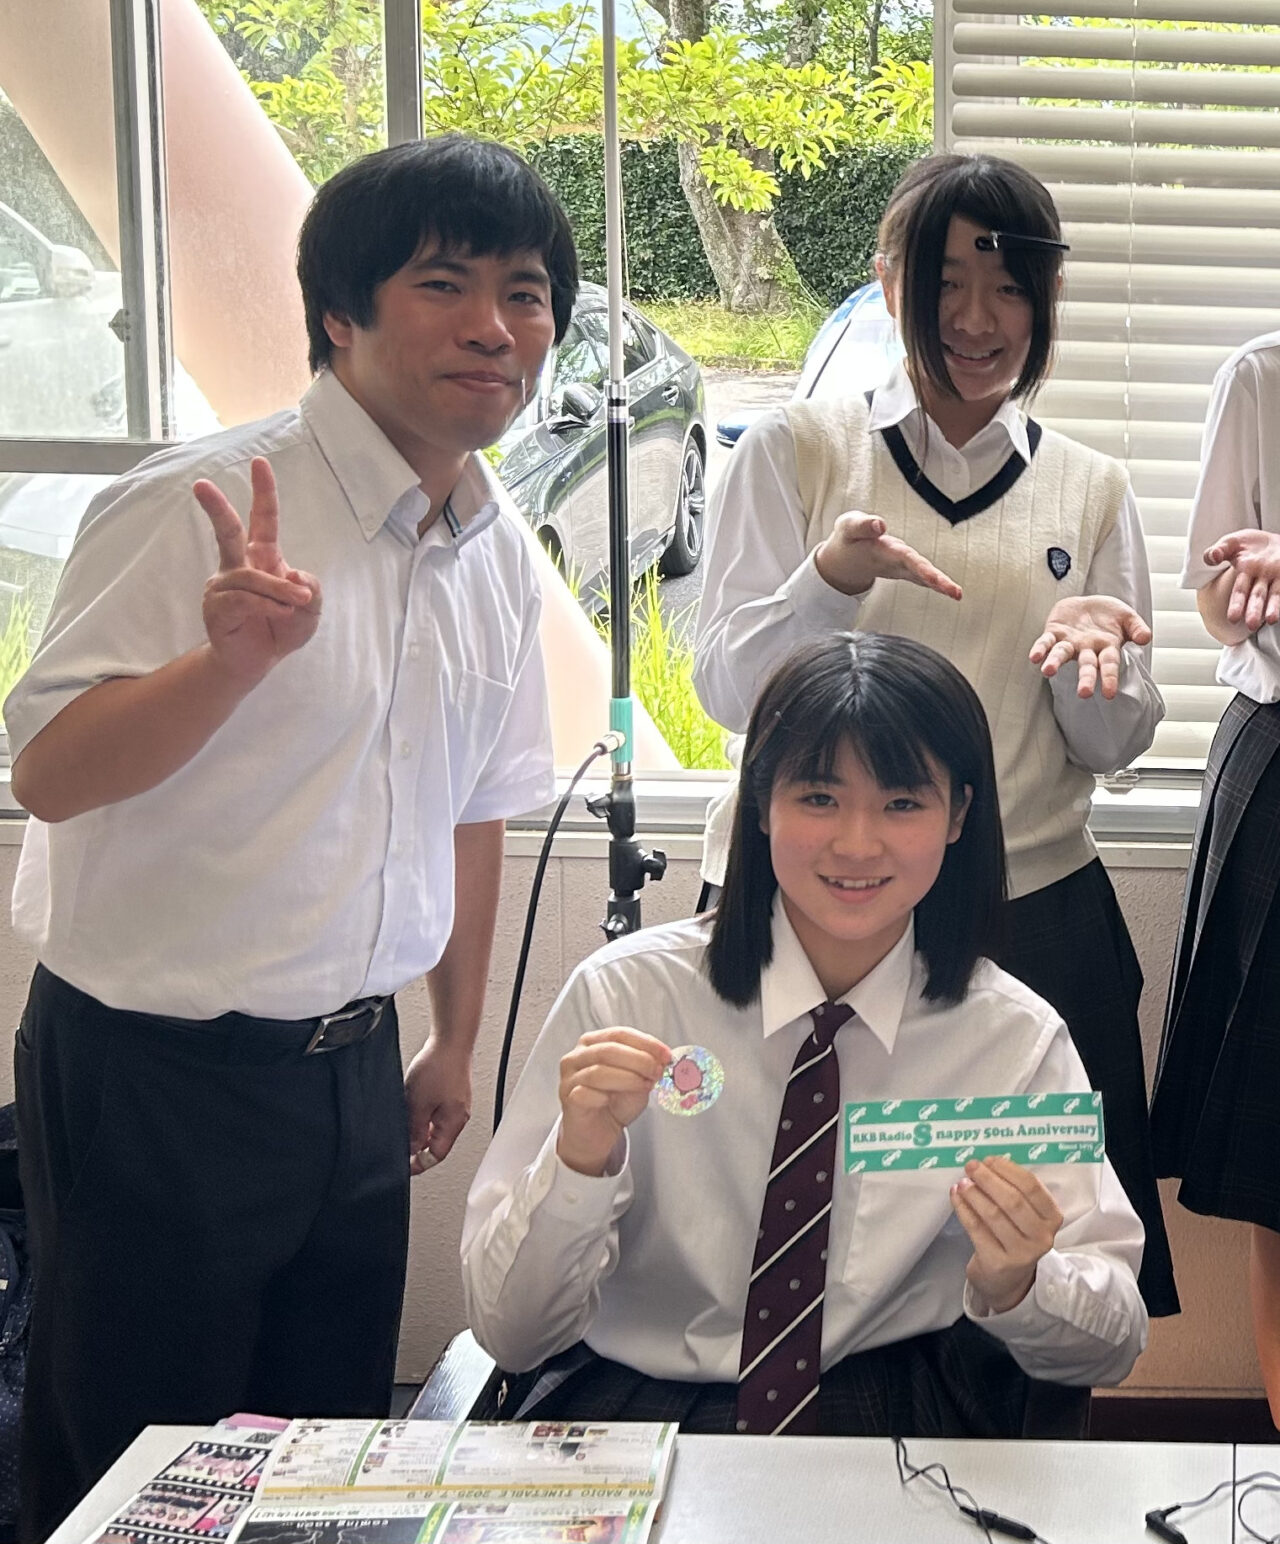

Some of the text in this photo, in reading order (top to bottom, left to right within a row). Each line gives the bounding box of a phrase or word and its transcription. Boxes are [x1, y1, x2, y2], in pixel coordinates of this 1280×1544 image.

[852, 1132, 877, 1144] RKB
[879, 1130, 912, 1143] Radio
[984, 1126, 1014, 1139] 50th
[1017, 1123, 1097, 1139] Anniversary
[499, 1488, 573, 1499] TIMETABLE
[580, 1488, 623, 1498] RADIO
